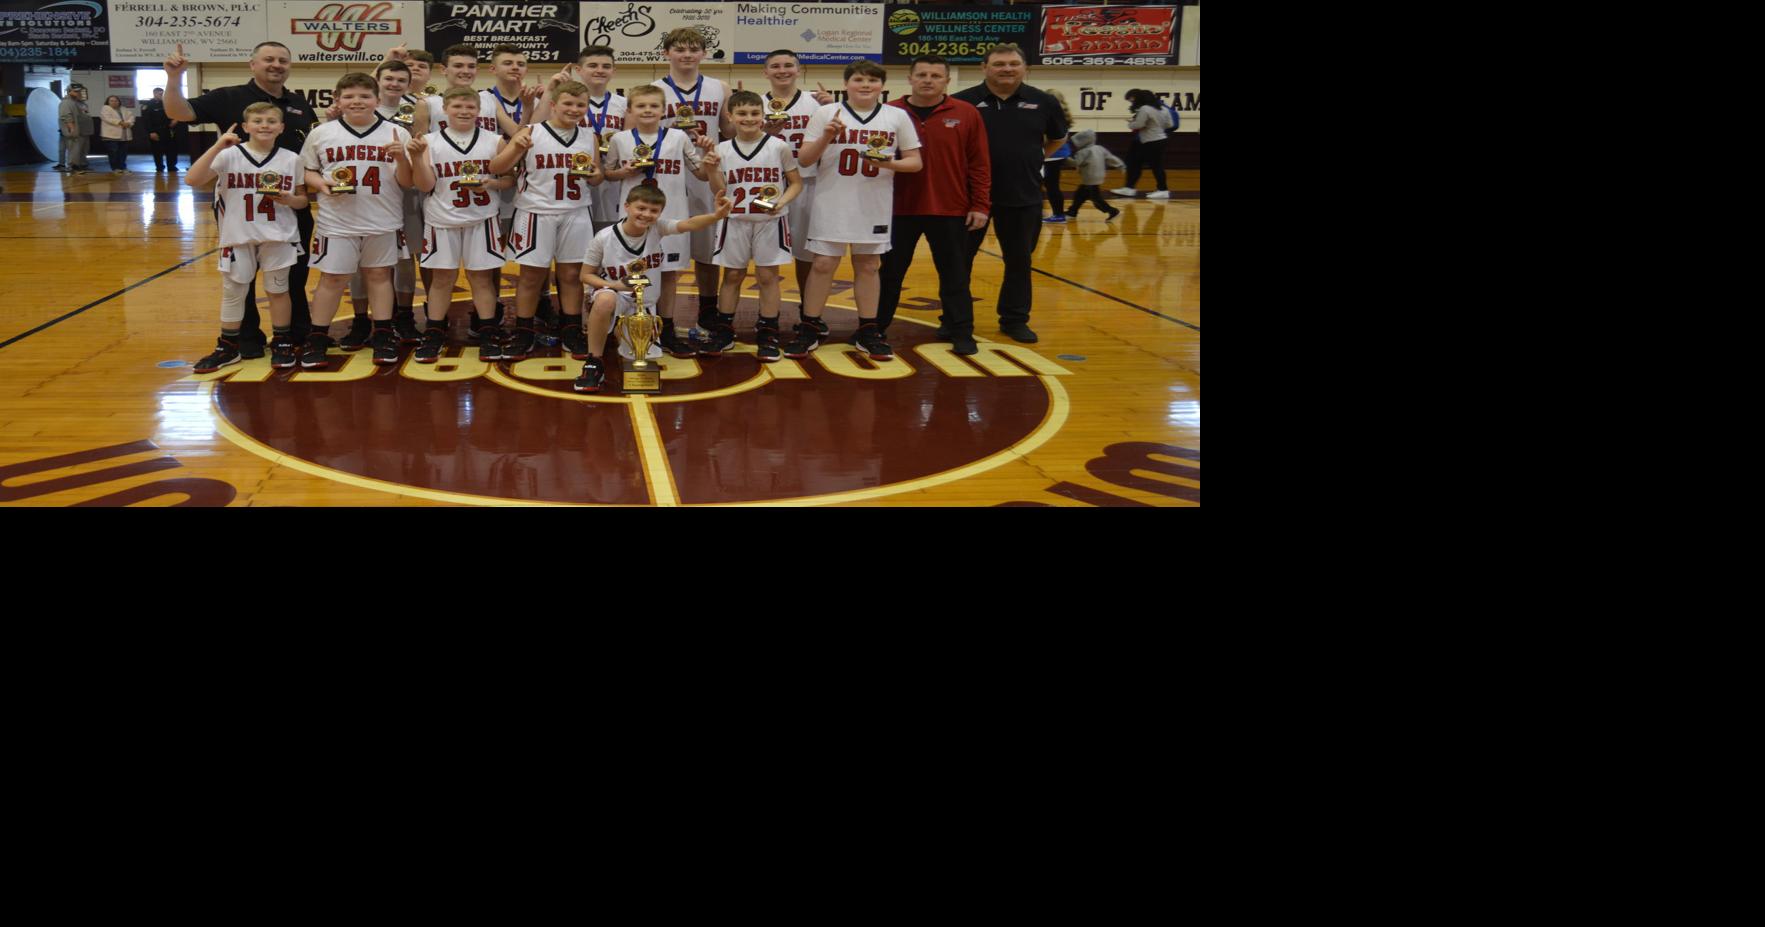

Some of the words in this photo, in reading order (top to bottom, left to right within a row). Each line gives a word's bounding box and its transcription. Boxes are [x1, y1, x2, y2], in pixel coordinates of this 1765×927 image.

[182, 4, 228, 12] BROWN,
[231, 4, 260, 12] PLLC
[450, 4, 558, 17] PANTHER
[736, 4, 787, 16] Making
[791, 4, 879, 15] Communities
[135, 16, 241, 27] 304-235-5674
[736, 16, 799, 26] Healthier
[920, 11, 987, 20] WILLIAMSON
[991, 12, 1031, 20] HEALTH
[304, 22, 390, 31] WALTERS
[472, 20, 538, 32] MART
[925, 25, 981, 33] WELLNESS
[984, 25, 1025, 33] CENTER
[898, 42, 1018, 56] 304-236-59
[1042, 57, 1167, 66] 606-369-4855
[1081, 91, 1112, 111] OF
[728, 166, 780, 184] ANGERS
[227, 172, 294, 191] RANGRS
[553, 172, 582, 200] 15
[243, 193, 276, 222] 14
